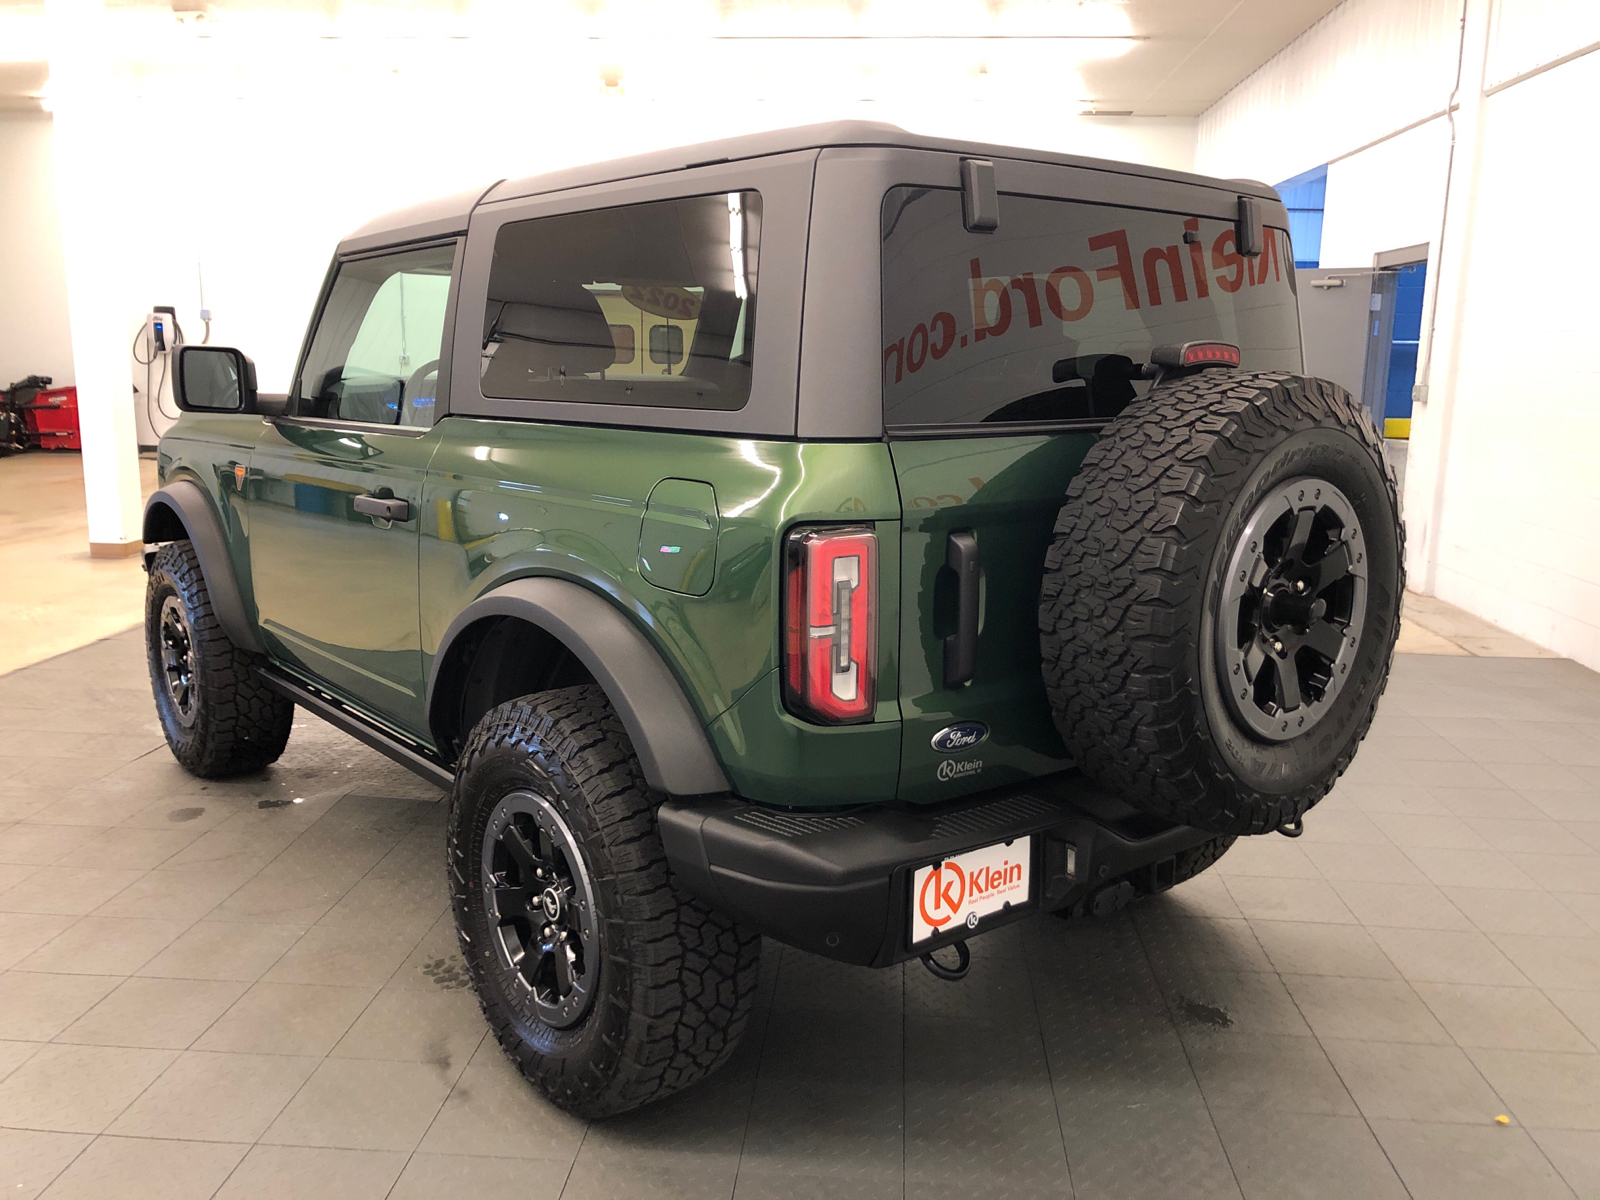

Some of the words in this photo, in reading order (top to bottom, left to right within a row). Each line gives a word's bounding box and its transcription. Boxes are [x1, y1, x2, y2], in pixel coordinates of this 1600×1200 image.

[946, 730, 977, 748] Ford
[956, 758, 983, 773] Klein
[968, 860, 1022, 898] Klein
